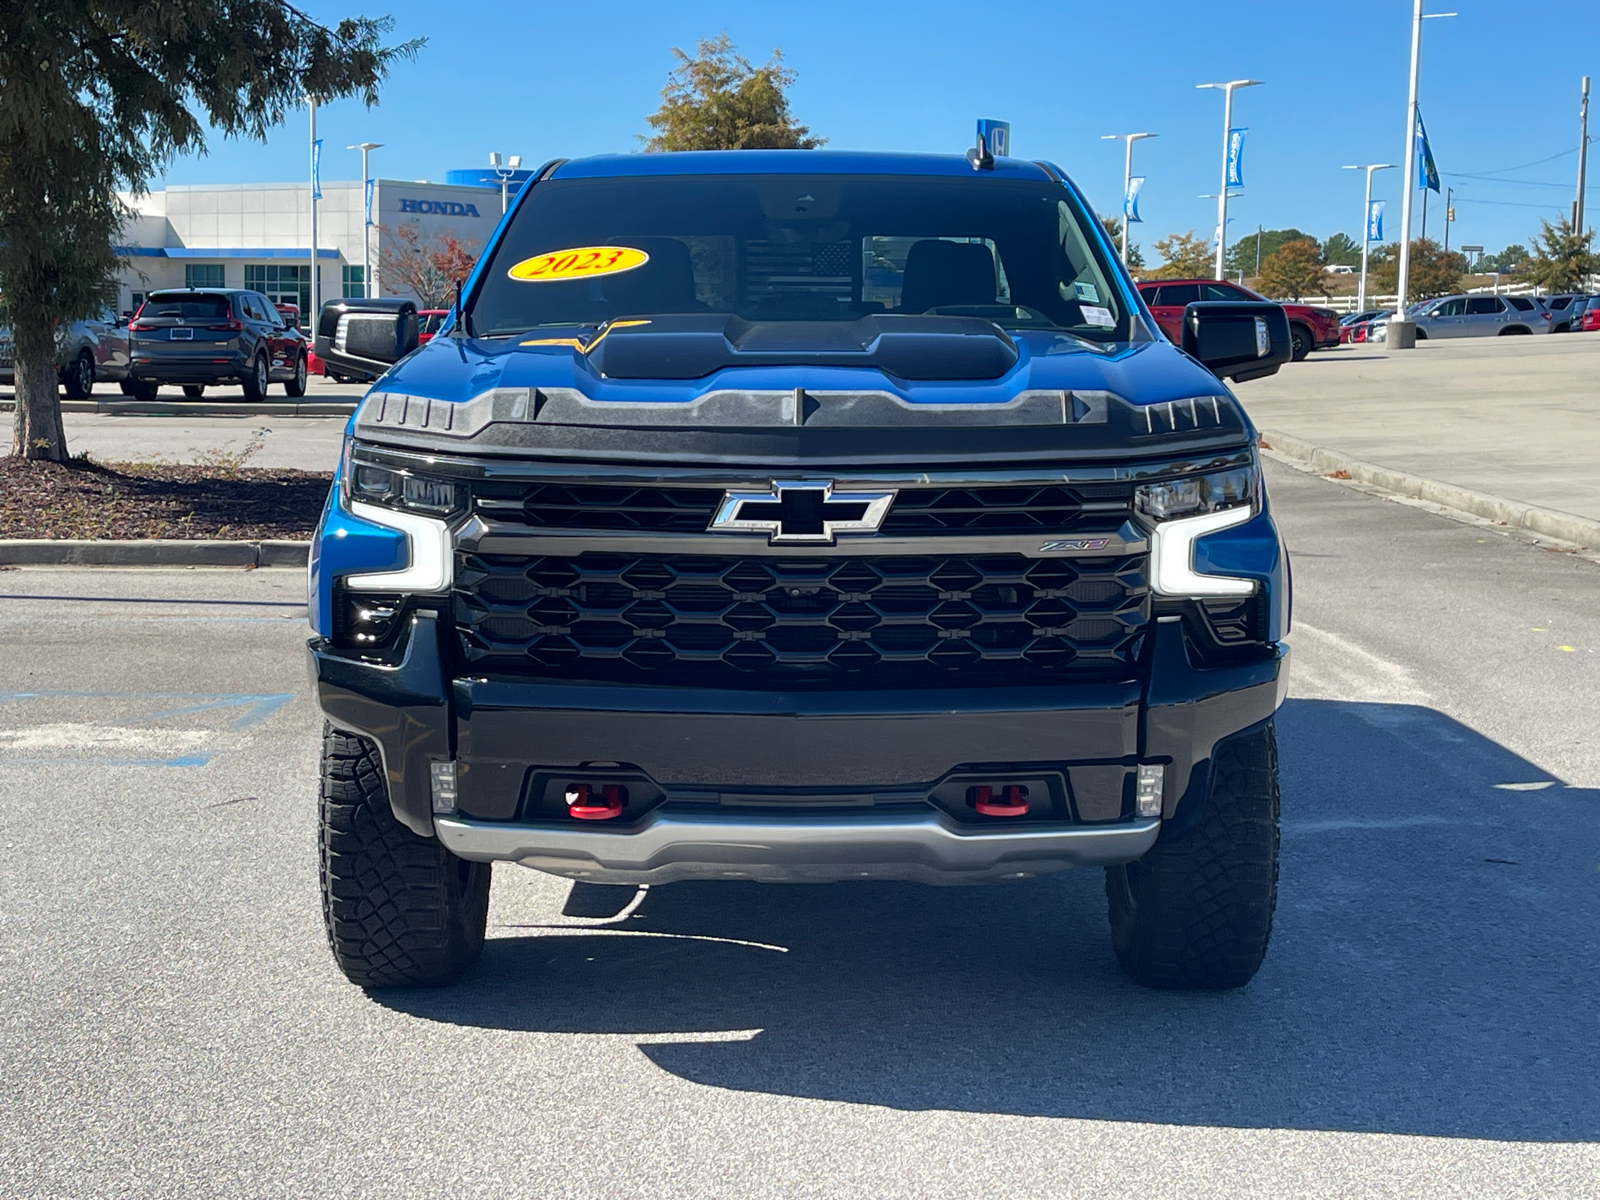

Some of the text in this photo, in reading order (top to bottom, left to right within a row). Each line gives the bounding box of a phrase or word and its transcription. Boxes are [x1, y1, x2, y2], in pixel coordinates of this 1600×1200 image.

[1229, 132, 1239, 183] MIDLANDS
[399, 198, 481, 217] HONDA
[526, 250, 624, 276] 2023
